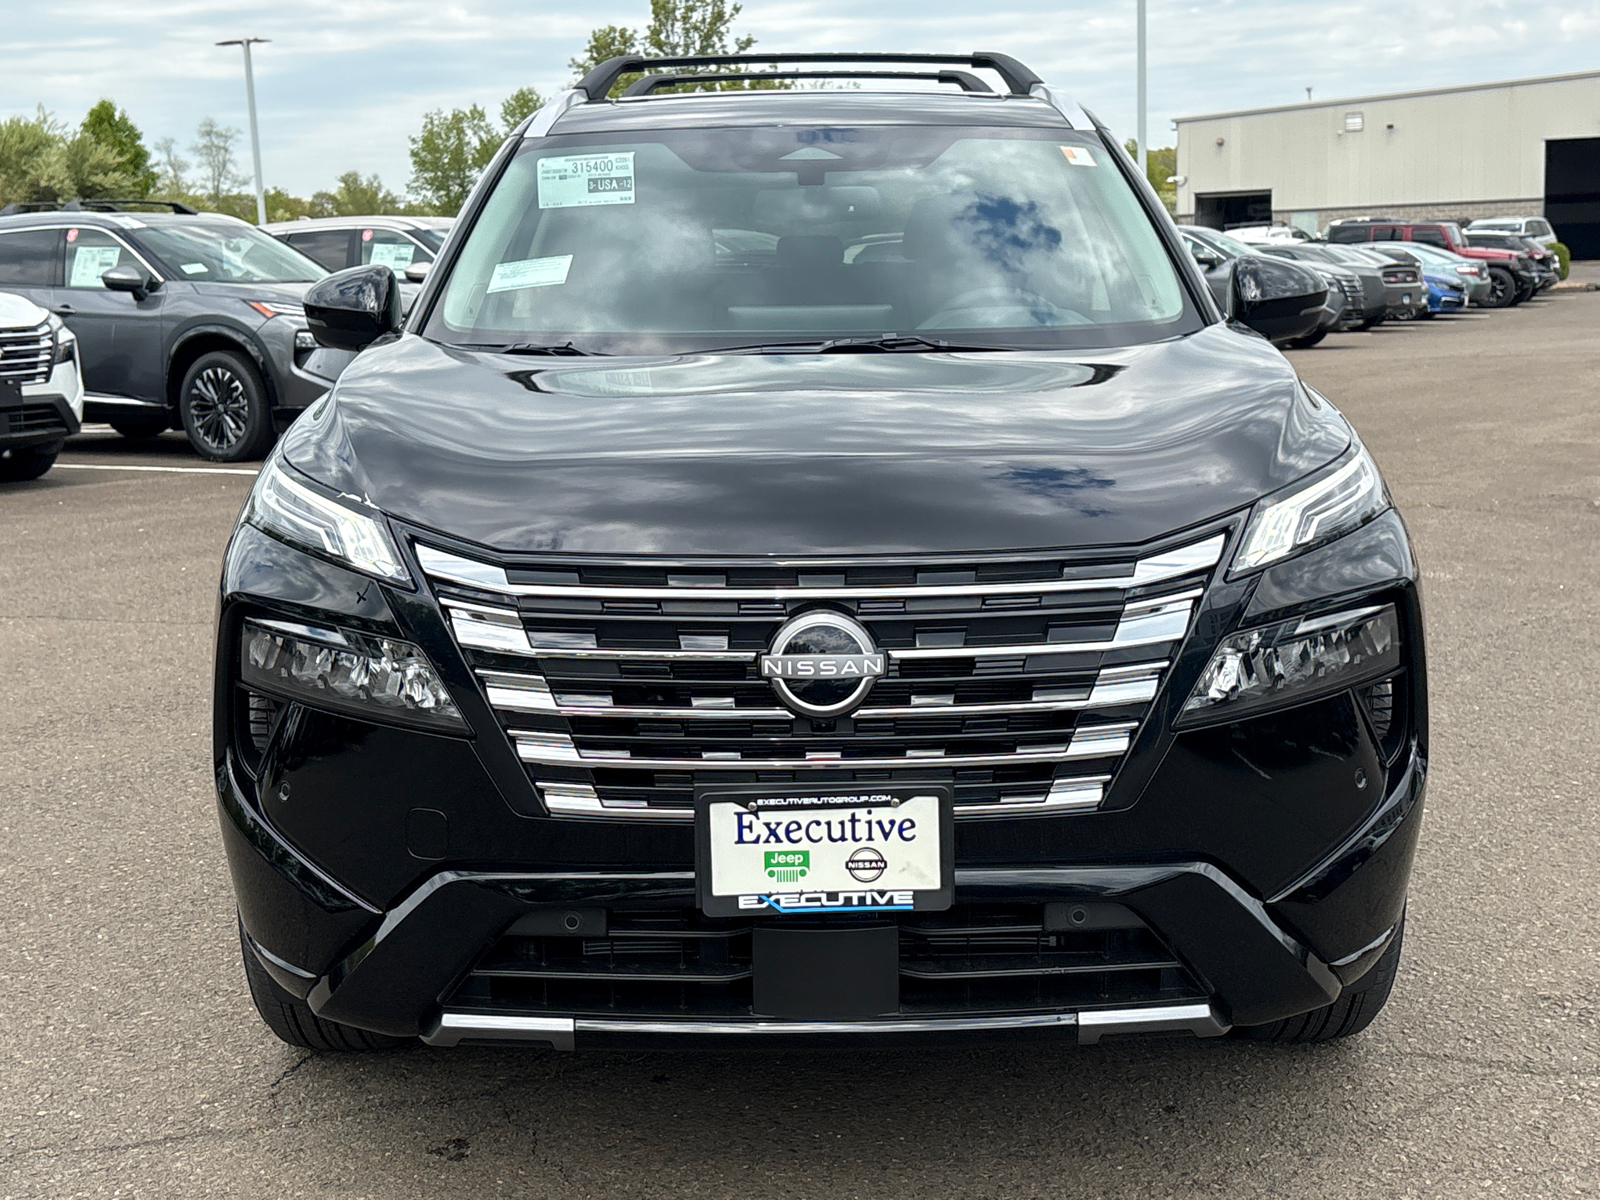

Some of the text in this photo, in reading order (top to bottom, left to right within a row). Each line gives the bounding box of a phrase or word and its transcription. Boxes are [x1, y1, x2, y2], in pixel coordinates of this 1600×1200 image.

[572, 159, 613, 174] 315400
[597, 178, 618, 190] USA
[764, 658, 881, 675] NISSAN
[756, 795, 892, 806] EXECUTIVEAUTOGROUP.COM
[734, 809, 917, 845] Executive
[770, 852, 804, 865] Jeep
[848, 860, 886, 870] NISSAN
[738, 890, 914, 910] EXECUTIVE
